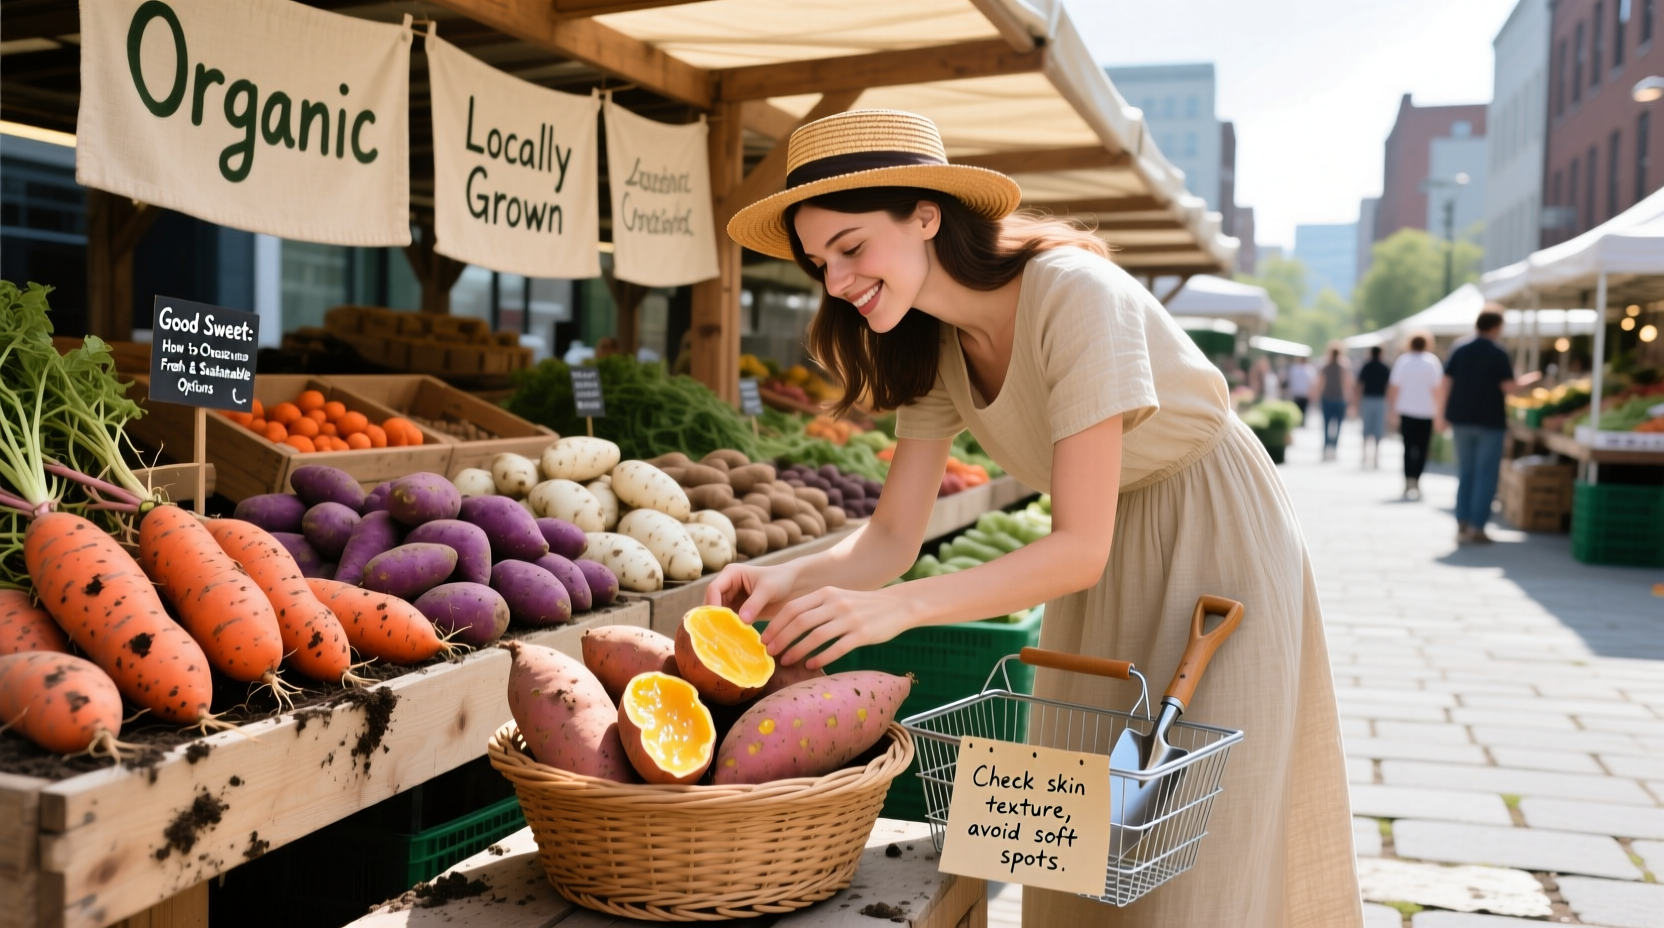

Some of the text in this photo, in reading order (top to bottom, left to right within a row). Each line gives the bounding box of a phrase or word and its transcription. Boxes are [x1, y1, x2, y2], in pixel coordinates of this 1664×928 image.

[126, 0, 379, 184] Organic
[465, 94, 572, 194] Locally
[465, 165, 563, 236] Grown
[158, 306, 254, 342] Good Sweet:
[162, 338, 185, 353] How
[972, 764, 1086, 796] Check skin
[985, 795, 1072, 824] texture,
[967, 822, 1078, 848] avoid soft
[1000, 849, 1065, 874] spots.
